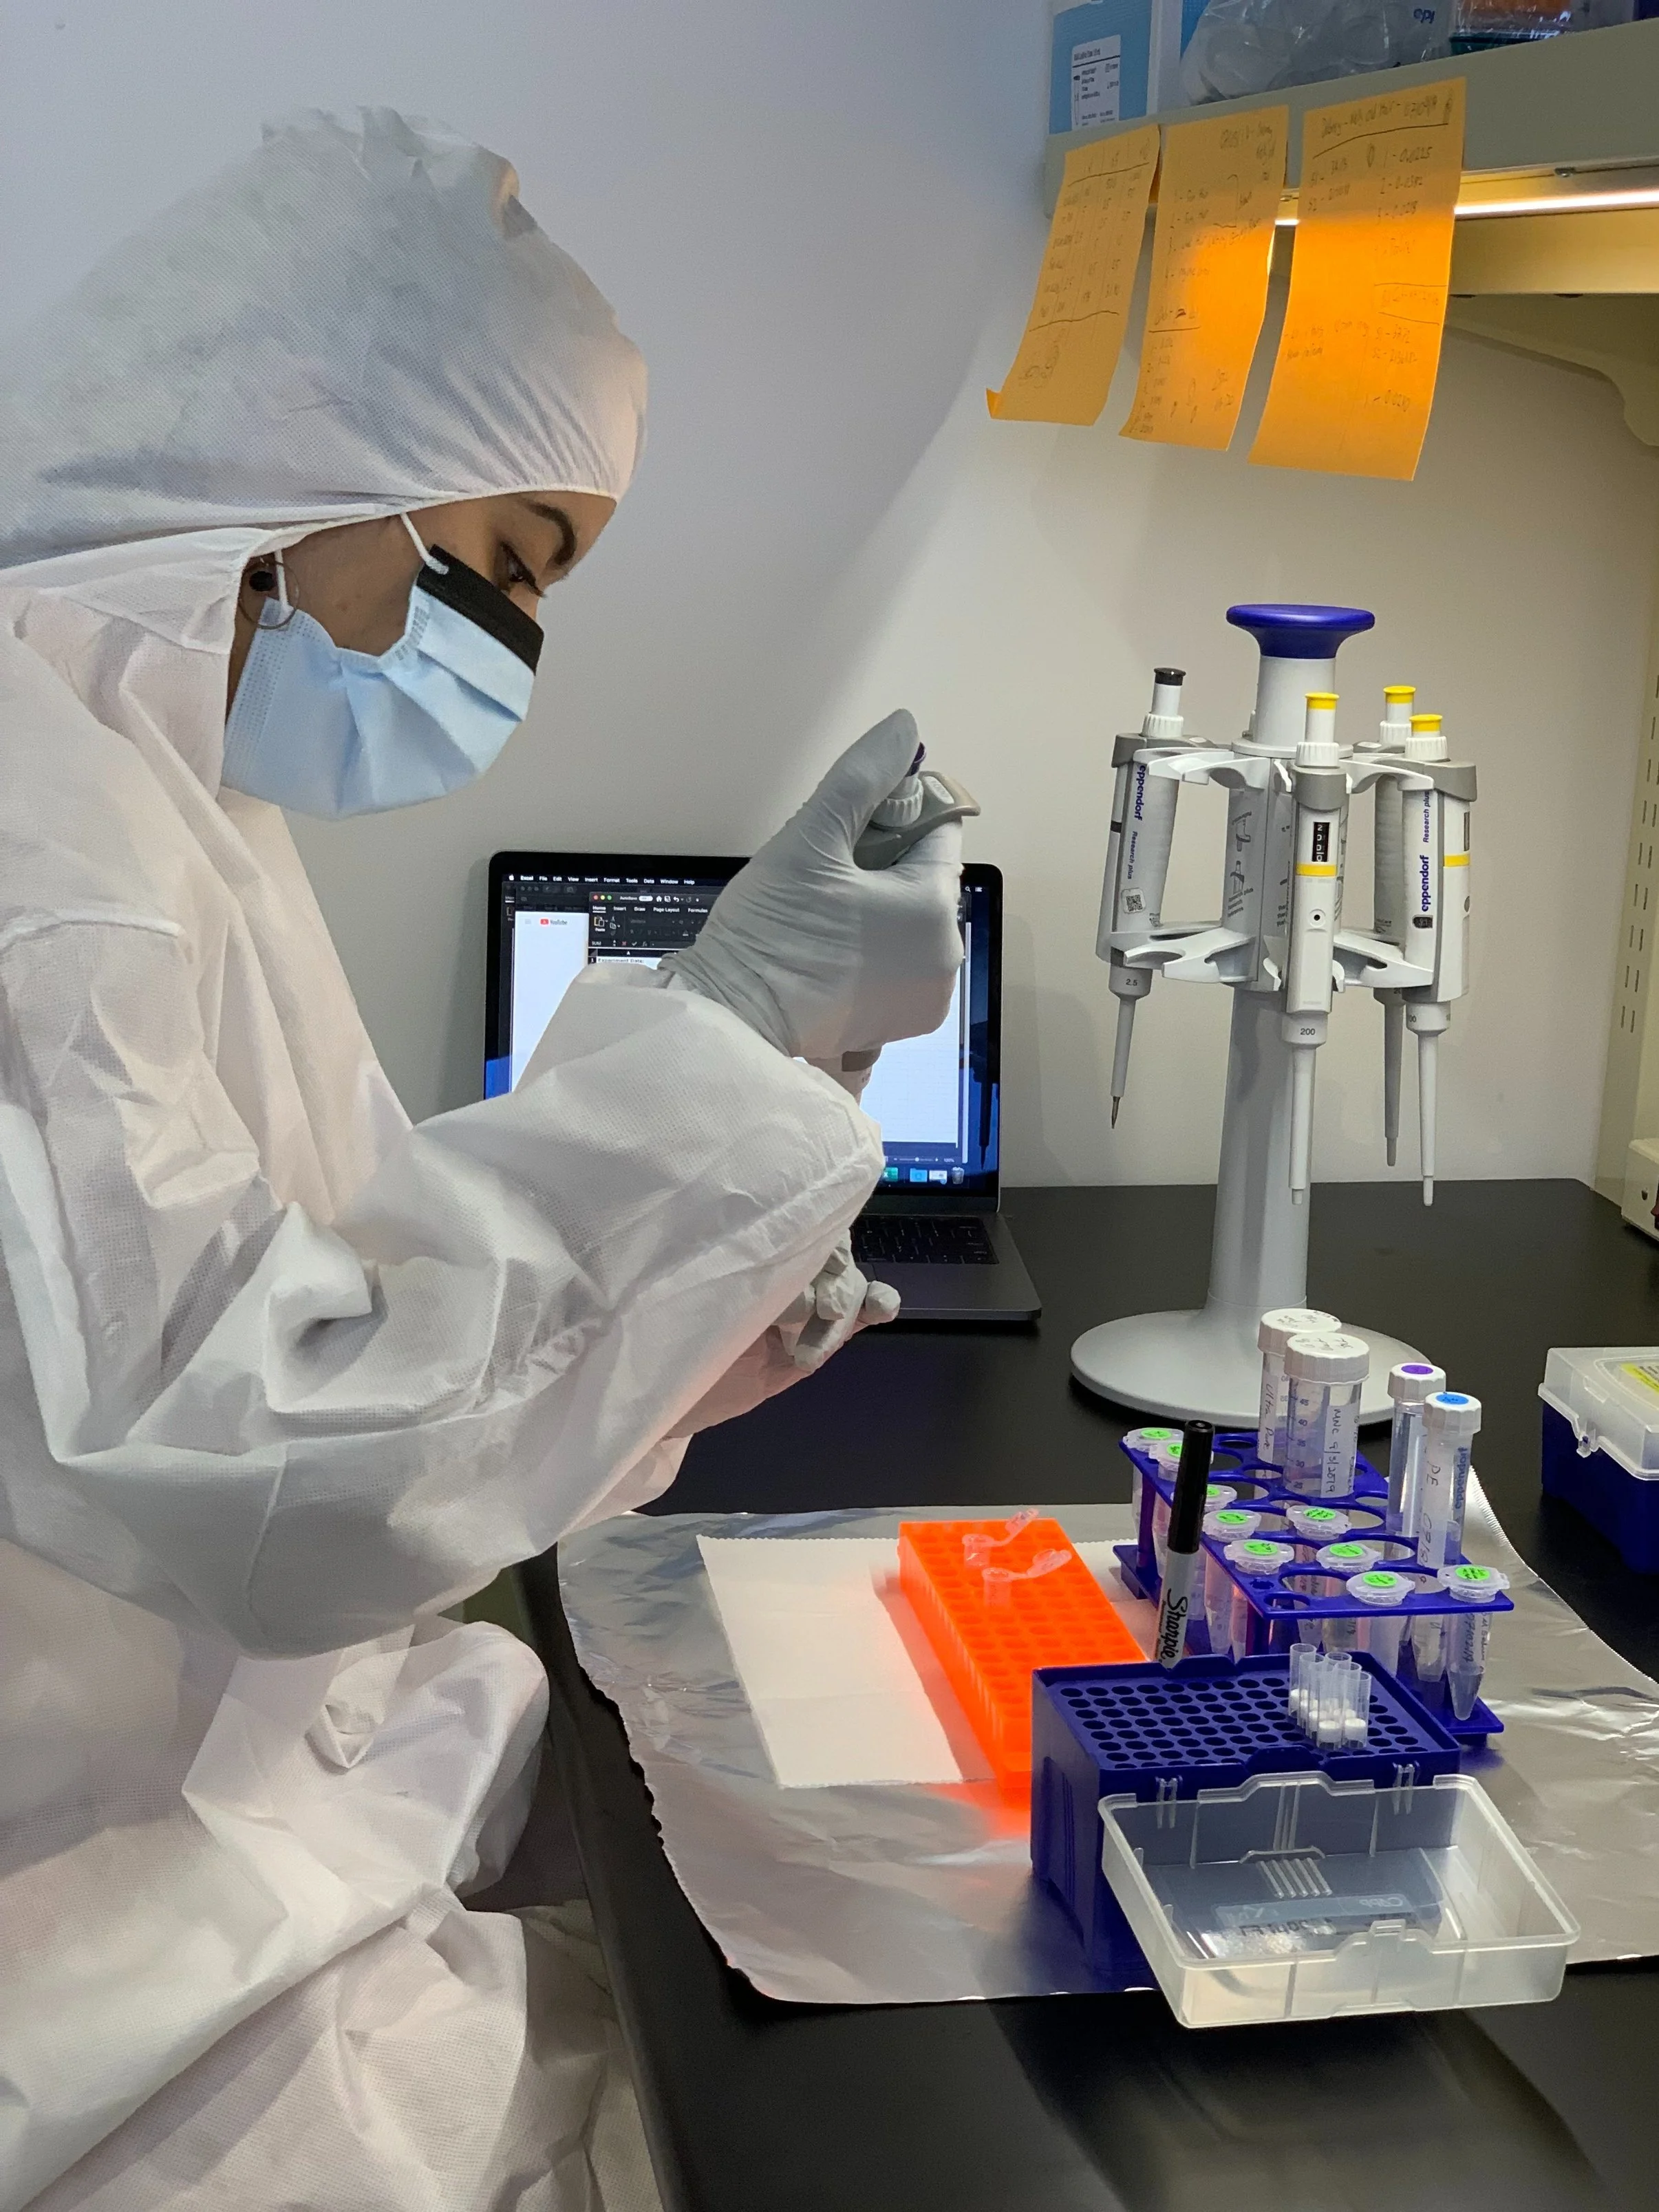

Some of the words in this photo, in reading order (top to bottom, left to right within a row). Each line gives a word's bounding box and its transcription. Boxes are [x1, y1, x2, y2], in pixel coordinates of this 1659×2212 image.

[1134, 764, 1146, 821] eppendorf
[1129, 830, 1138, 863] Research
[1420, 855, 1431, 912] eppendorf
[1126, 978, 1138, 987] 2.5
[1455, 1447, 1468, 1510] eppendorf
